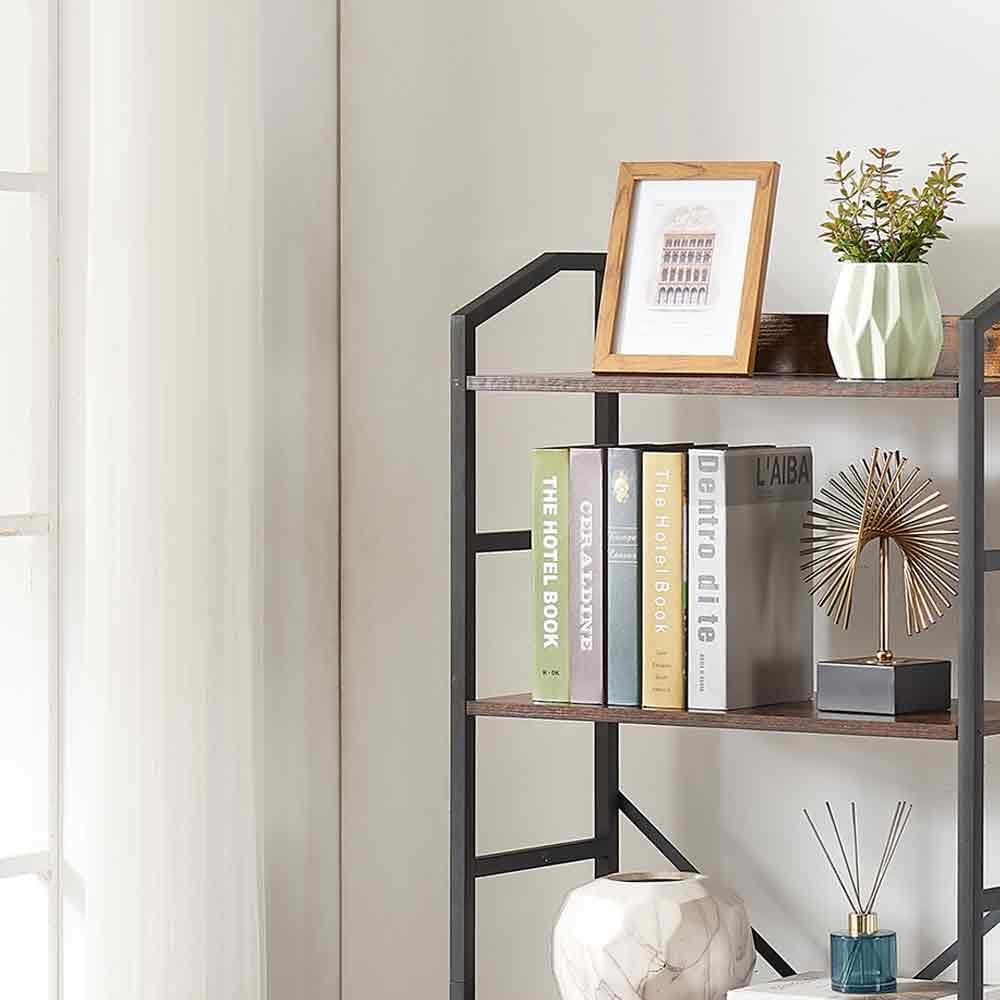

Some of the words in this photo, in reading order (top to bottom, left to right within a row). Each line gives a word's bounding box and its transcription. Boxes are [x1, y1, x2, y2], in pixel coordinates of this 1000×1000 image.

[543, 475, 558, 516] THE
[655, 469, 673, 507] The
[697, 455, 720, 559] Dentro
[543, 520, 559, 586] HOTEL
[655, 515, 673, 576] Hotel
[543, 591, 560, 649] BOOK
[655, 581, 672, 633] Book
